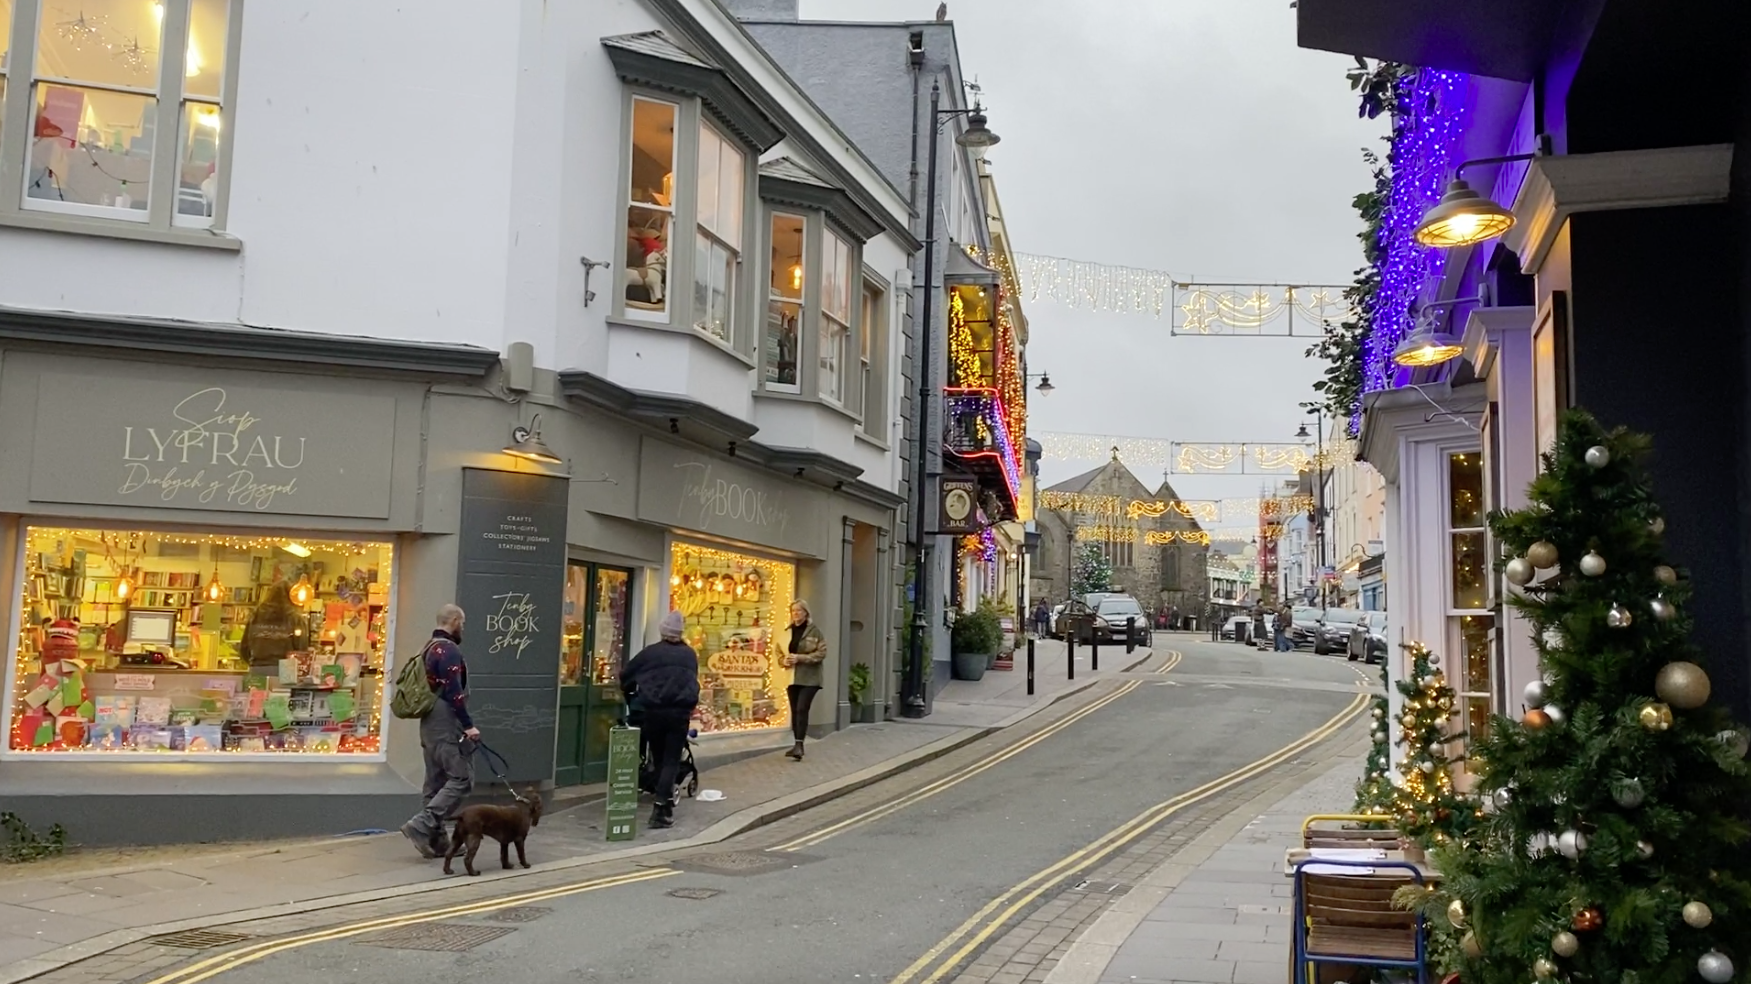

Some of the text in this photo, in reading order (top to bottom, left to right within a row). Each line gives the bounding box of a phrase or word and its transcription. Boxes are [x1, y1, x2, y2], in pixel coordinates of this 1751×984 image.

[173, 387, 261, 446] Siop
[122, 426, 306, 469] LYFRAU
[199, 482, 224, 503] y
[716, 479, 767, 526] BOOK
[506, 515, 532, 523] CRAFTS
[950, 520, 966, 528] BAR
[498, 543, 537, 551] STATIONERY
[492, 591, 537, 622] Tenby
[486, 614, 540, 632] BOOK
[489, 625, 533, 659] shop
